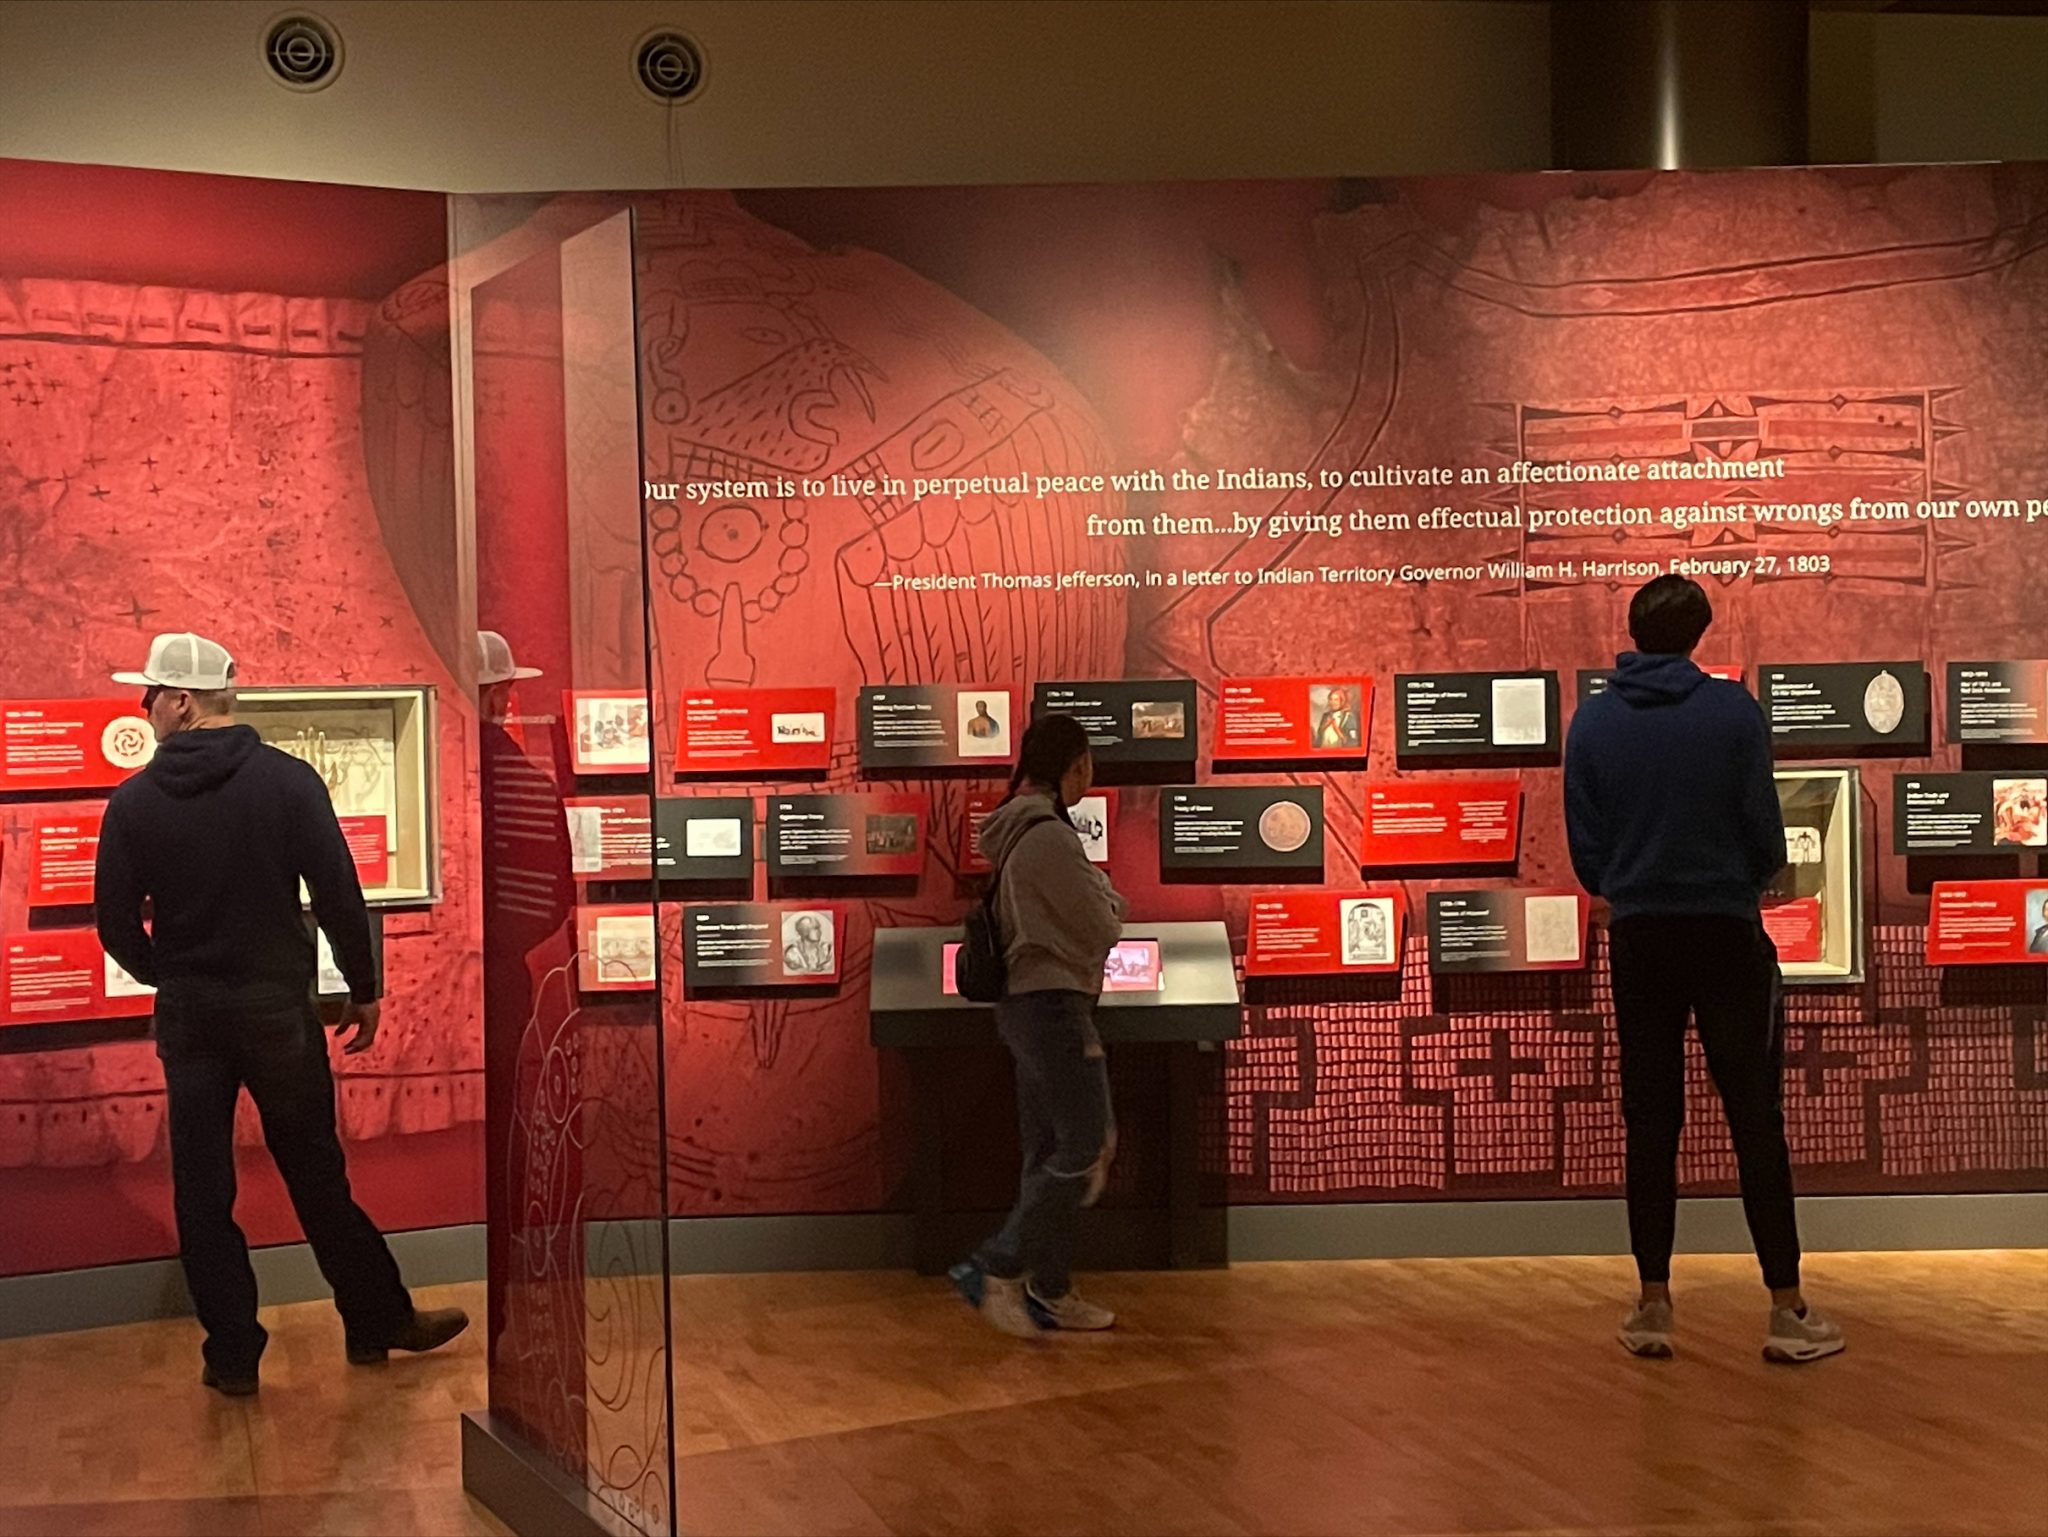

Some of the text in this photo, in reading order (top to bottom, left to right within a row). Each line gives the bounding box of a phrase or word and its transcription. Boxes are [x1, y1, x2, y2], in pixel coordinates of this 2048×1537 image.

[686, 479, 769, 505] system
[776, 475, 796, 498] is
[802, 478, 826, 497] to
[831, 474, 876, 497] live
[882, 474, 907, 496] in
[912, 472, 1030, 501] perpetual
[1035, 475, 1105, 500] peace
[1110, 470, 1166, 492] with
[1171, 468, 1211, 491] the
[1216, 467, 1313, 492] Indians,
[1319, 468, 1343, 488] to
[1349, 464, 1453, 487] cultivate
[1460, 468, 1490, 485] an
[1497, 461, 1641, 484] affectionate
[1646, 458, 1785, 481] attachment
[1086, 514, 1147, 536] from
[1267, 510, 1343, 539] giving
[1349, 509, 1411, 531] them
[1417, 505, 1523, 530] effectual
[1528, 502, 1653, 533] protection
[1659, 501, 1748, 529] against
[1752, 502, 1844, 527] wrongs
[1849, 497, 1910, 520] from
[1916, 501, 1961, 519] our
[1966, 499, 2021, 518] own
[981, 572, 1052, 589] Thomas
[1055, 571, 1140, 591] Jefferson,
[1145, 570, 1162, 586] in
[1166, 573, 1178, 586] a
[1182, 569, 1231, 586] letter
[1234, 570, 1253, 585] to
[1258, 567, 1314, 585] Indian
[1319, 566, 1396, 586] Territory
[1400, 564, 1484, 582] Governor
[1488, 562, 1554, 579] William
[1558, 561, 1577, 578] H.
[1582, 559, 1665, 578] Harrison,
[1669, 557, 1751, 579] February
[1755, 557, 1782, 576] 27,
[1787, 555, 1831, 573] 1803
